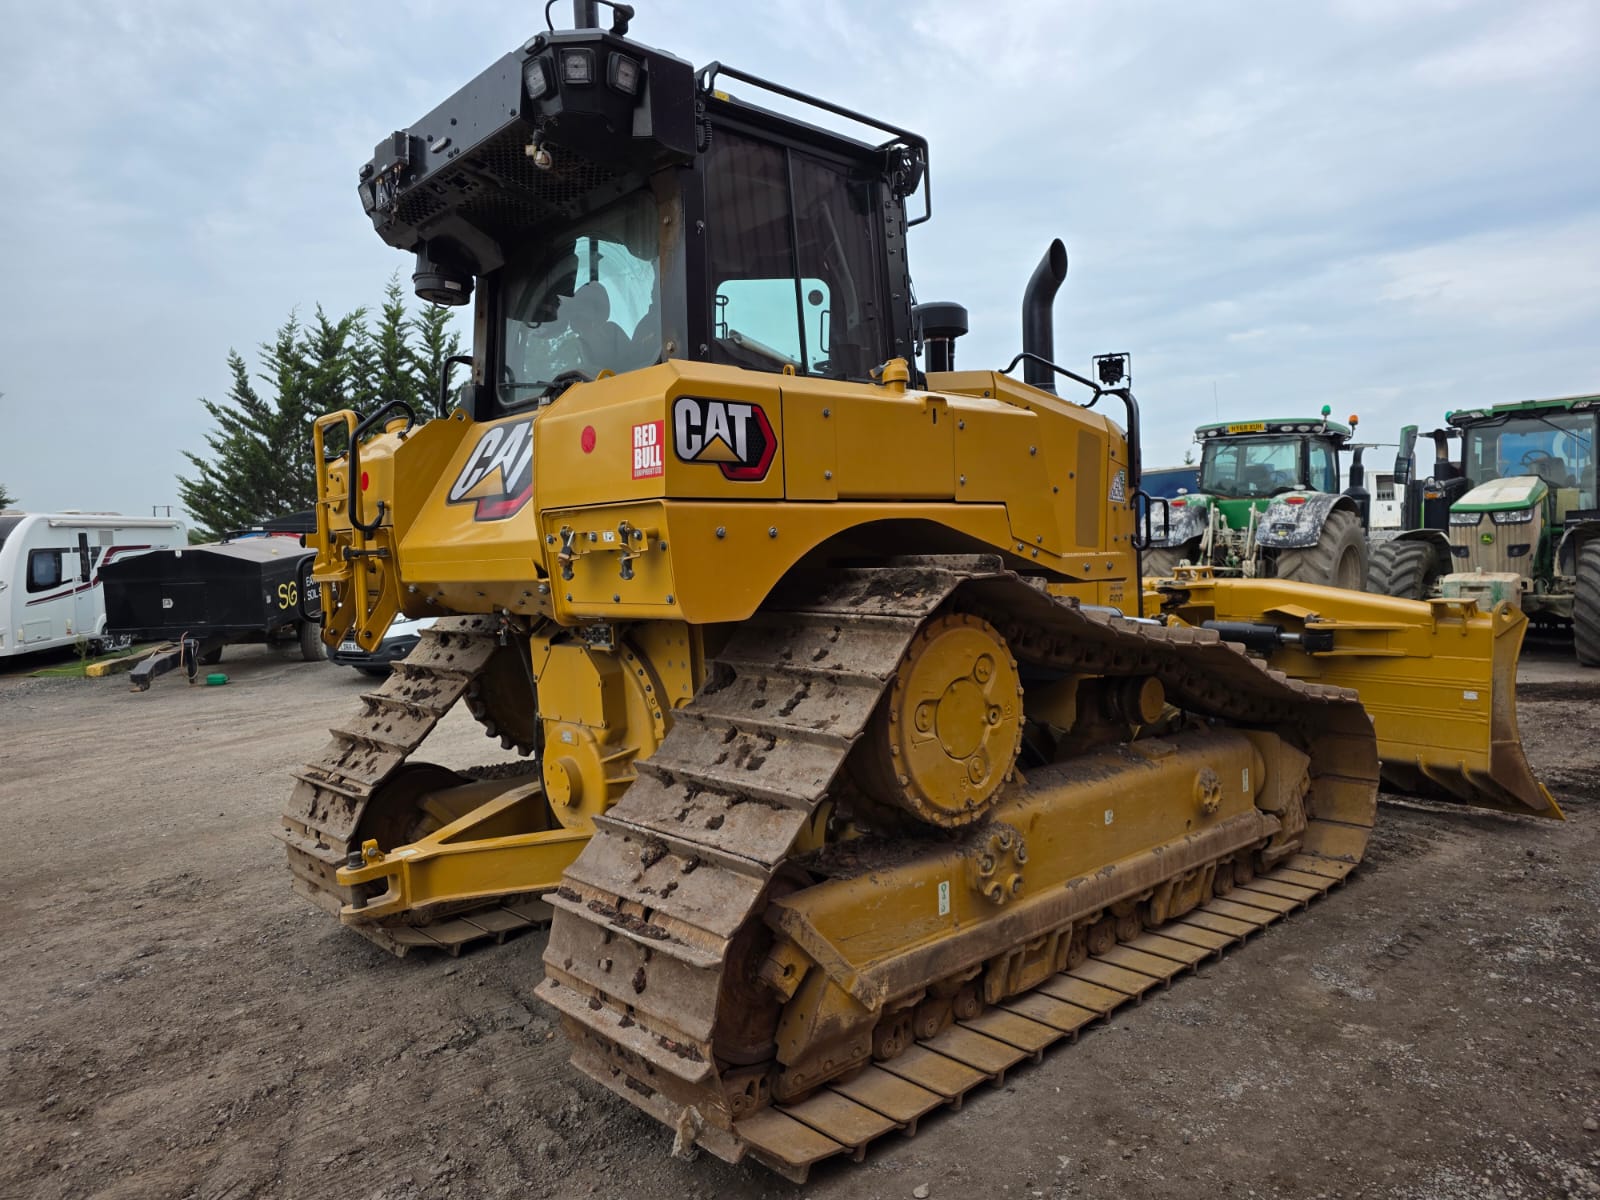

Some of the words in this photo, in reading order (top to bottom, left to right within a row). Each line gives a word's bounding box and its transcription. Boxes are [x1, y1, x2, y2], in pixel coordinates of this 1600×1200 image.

[634, 423, 657, 448] RED
[674, 398, 752, 463] CAT
[634, 444, 662, 470] BULL
[278, 581, 298, 609] SG
